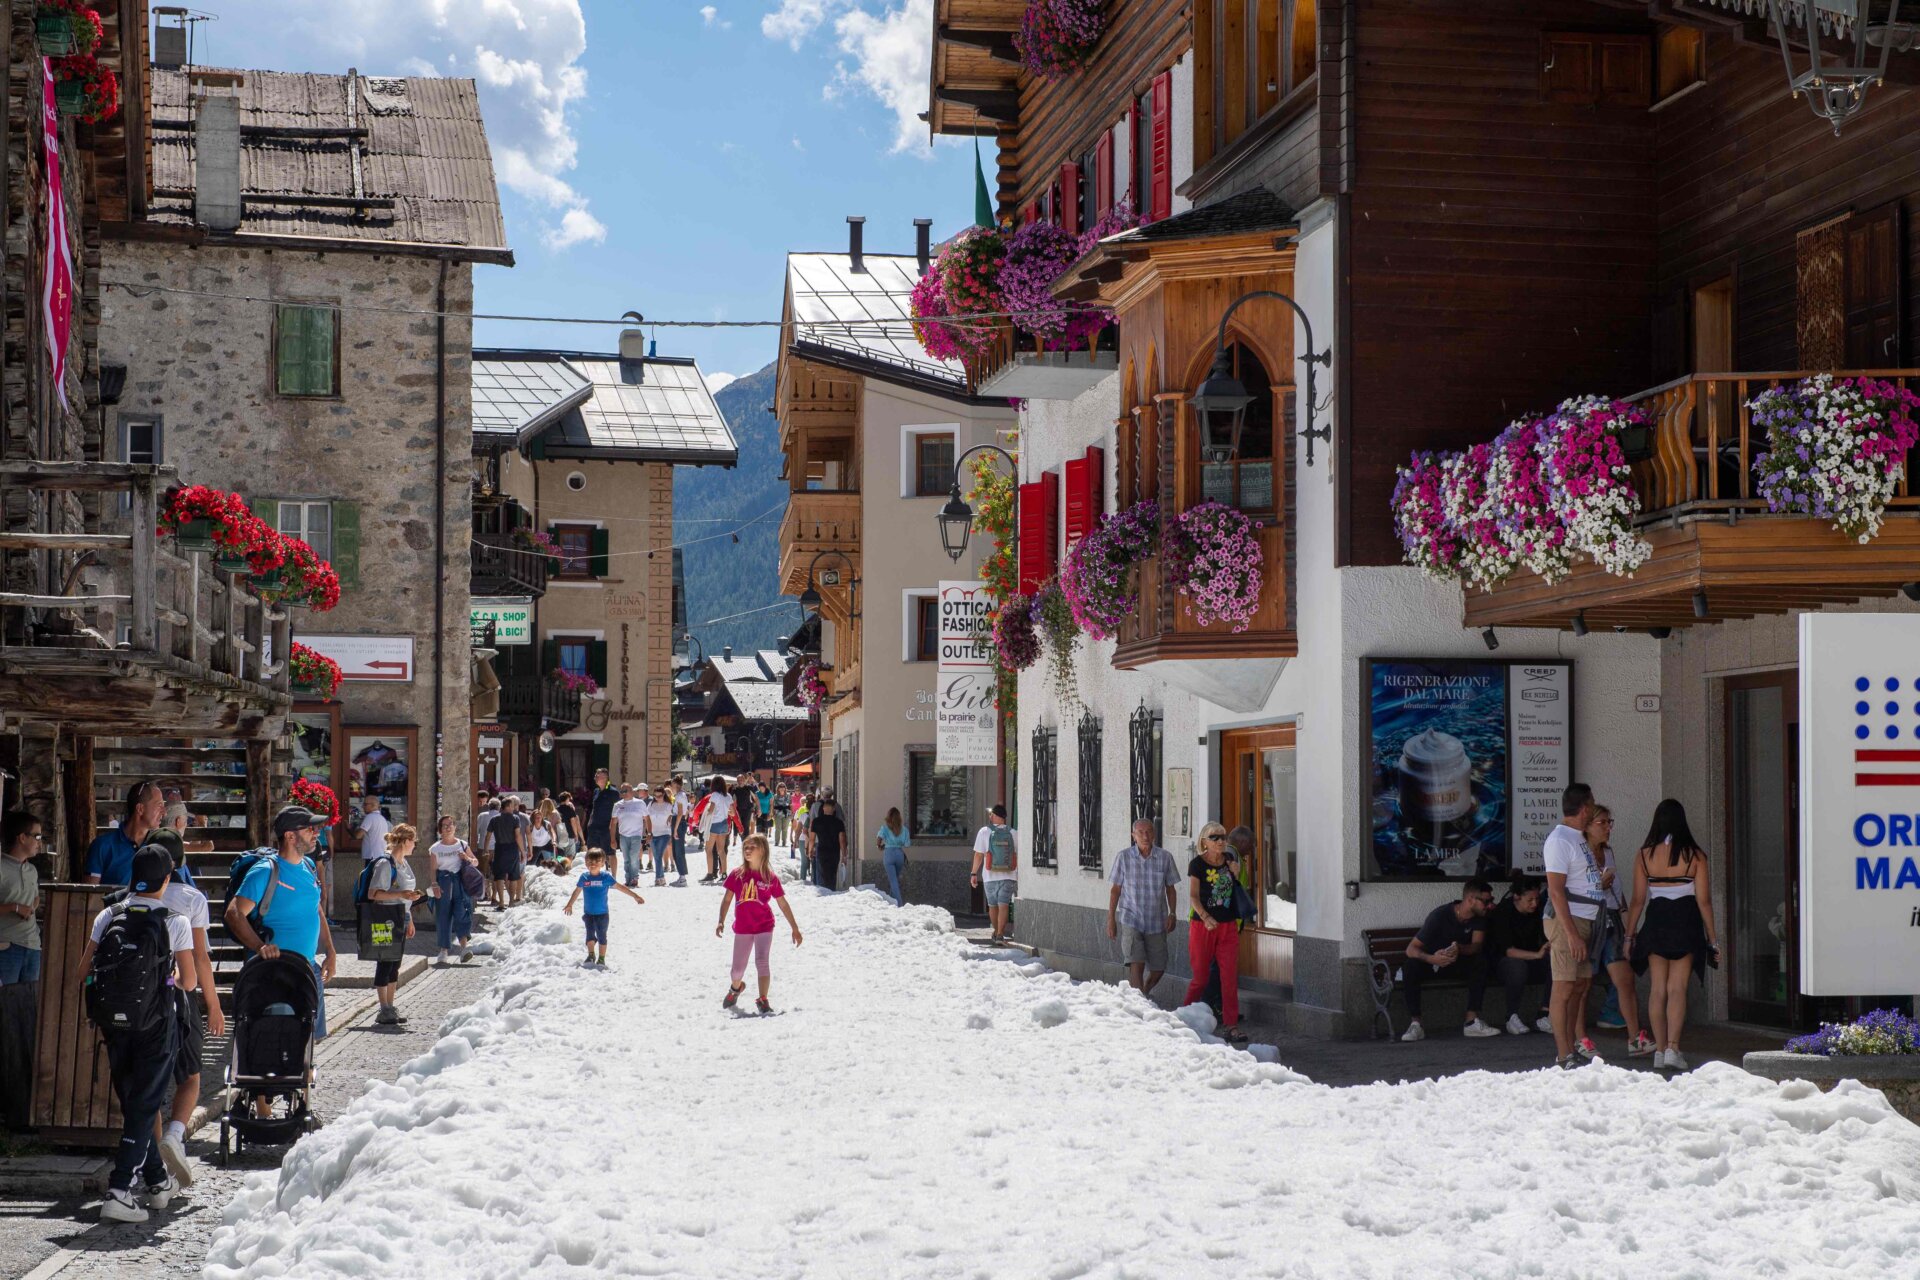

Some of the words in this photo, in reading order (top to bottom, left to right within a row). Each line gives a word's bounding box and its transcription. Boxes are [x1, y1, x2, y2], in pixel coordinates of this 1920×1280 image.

[943, 601, 993, 616] OTTICA
[503, 612, 527, 621] SHOP
[942, 645, 993, 659] OUTLET
[621, 623, 629, 705] RISTORANTE
[1523, 668, 1557, 676] CREED
[1383, 675, 1491, 688] RIGENERAZIONE
[1404, 688, 1430, 699] DAL
[1432, 688, 1470, 700] MARE
[1642, 700, 1654, 708] 83
[586, 699, 646, 732] Garden
[939, 711, 947, 721] la
[948, 712, 976, 724] prairie
[1522, 750, 1558, 766] Kilian
[1523, 798, 1536, 807] LA
[1538, 798, 1558, 808] MER
[1524, 812, 1557, 820] RODIN
[1434, 848, 1461, 859] MER
[1526, 864, 1546, 872] sisl
[1856, 856, 1920, 890] MA
